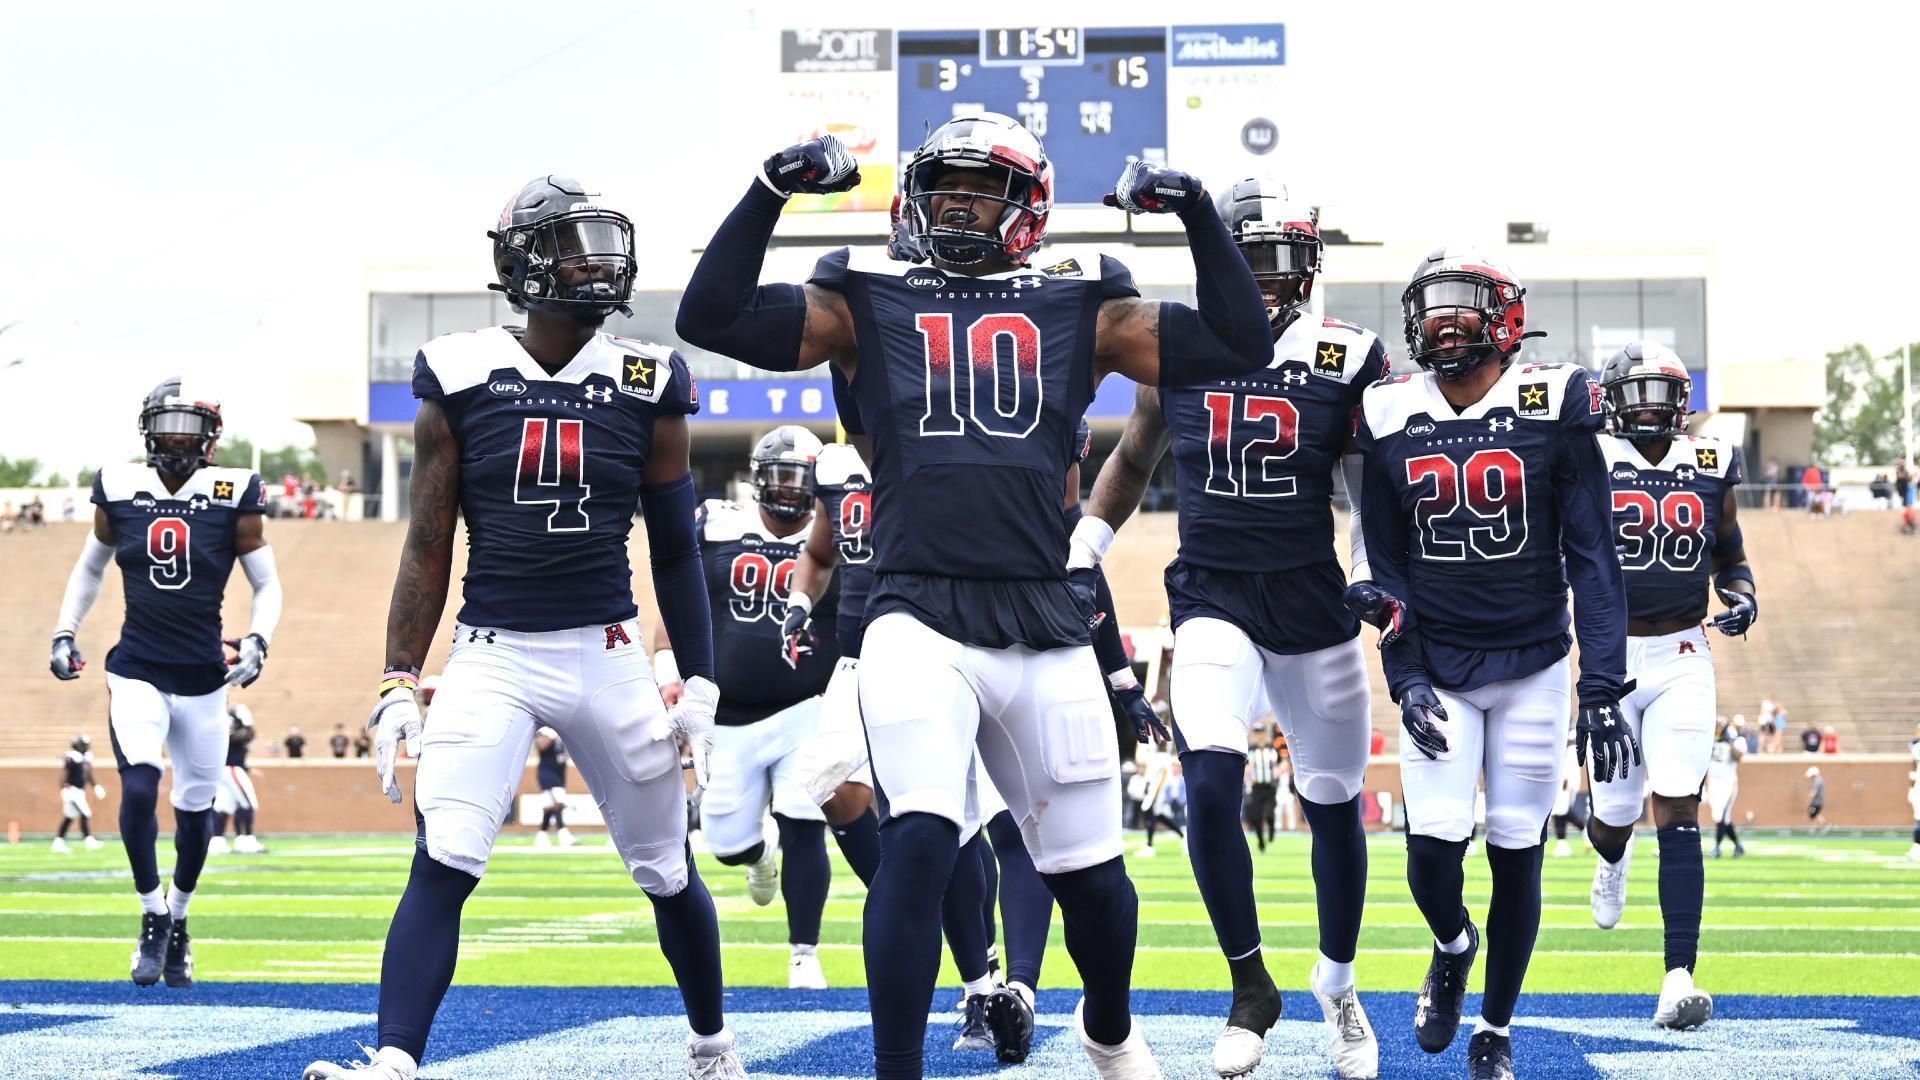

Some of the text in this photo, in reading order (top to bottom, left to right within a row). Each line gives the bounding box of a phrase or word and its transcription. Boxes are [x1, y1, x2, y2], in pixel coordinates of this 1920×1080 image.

[998, 27, 1076, 58] 11:54
[939, 59, 958, 91] 3
[1117, 56, 1149, 88] 15
[1026, 77, 1040, 100] 3
[915, 312, 1043, 439] 10
[1220, 380, 1290, 391] HOUSTON
[1324, 369, 1342, 378] ARMY
[514, 398, 594, 410] HOUSTON
[622, 384, 654, 397] U.S. ARMY
[1531, 408, 1549, 416] ARMY
[1203, 391, 1300, 498] 12
[1426, 435, 1495, 447] HOUSTON
[513, 417, 591, 533] 4
[1405, 447, 1529, 560] 29
[1611, 489, 1706, 572] 38
[146, 516, 192, 590] 9
[728, 552, 797, 626] 99
